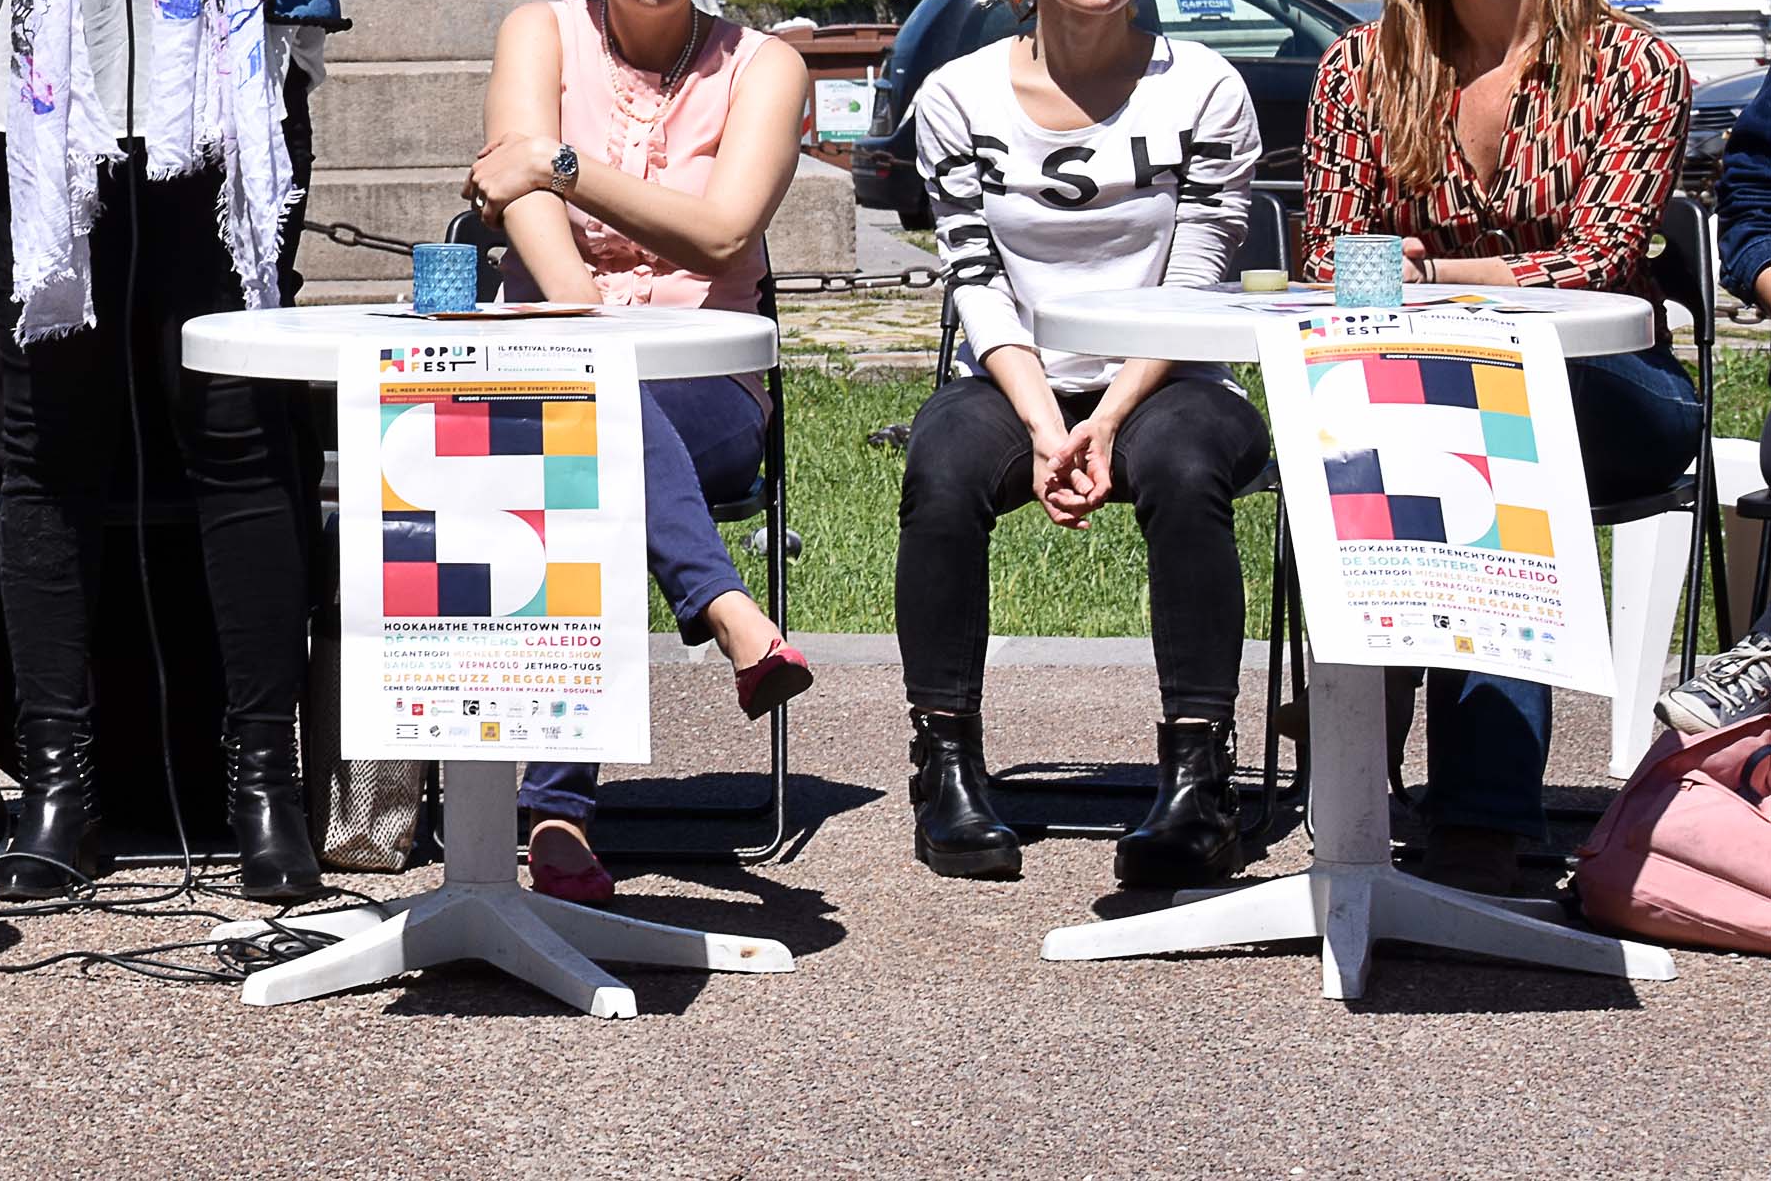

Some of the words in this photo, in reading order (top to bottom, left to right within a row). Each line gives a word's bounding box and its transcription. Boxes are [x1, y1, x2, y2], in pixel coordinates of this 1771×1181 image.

[412, 346, 476, 357] POPUP
[411, 361, 476, 372] FEST
[1432, 547, 1516, 564] TRENCHTOWN
[1520, 558, 1556, 571] TRAIN
[1368, 556, 1412, 566] SODA
[1417, 558, 1478, 572] SISTERS
[1485, 565, 1558, 584] CALEIDO
[1489, 588, 1562, 606] JETHRO-TUGS
[1468, 596, 1530, 612] REGGAE
[1537, 607, 1565, 619] SET
[384, 623, 468, 631] HOOKAH&THE
[473, 623, 559, 631] TRENCHTOWN
[564, 623, 601, 631] TRAIN
[525, 636, 601, 646] CALEIDO
[569, 651, 601, 659] SHOW
[459, 661, 519, 669] VERNACOLO
[525, 662, 601, 671] JETHRO-TUGS
[384, 674, 489, 683] DJFRANCUZZ
[503, 675, 566, 684] REGGAE
[574, 676, 602, 685] SET
